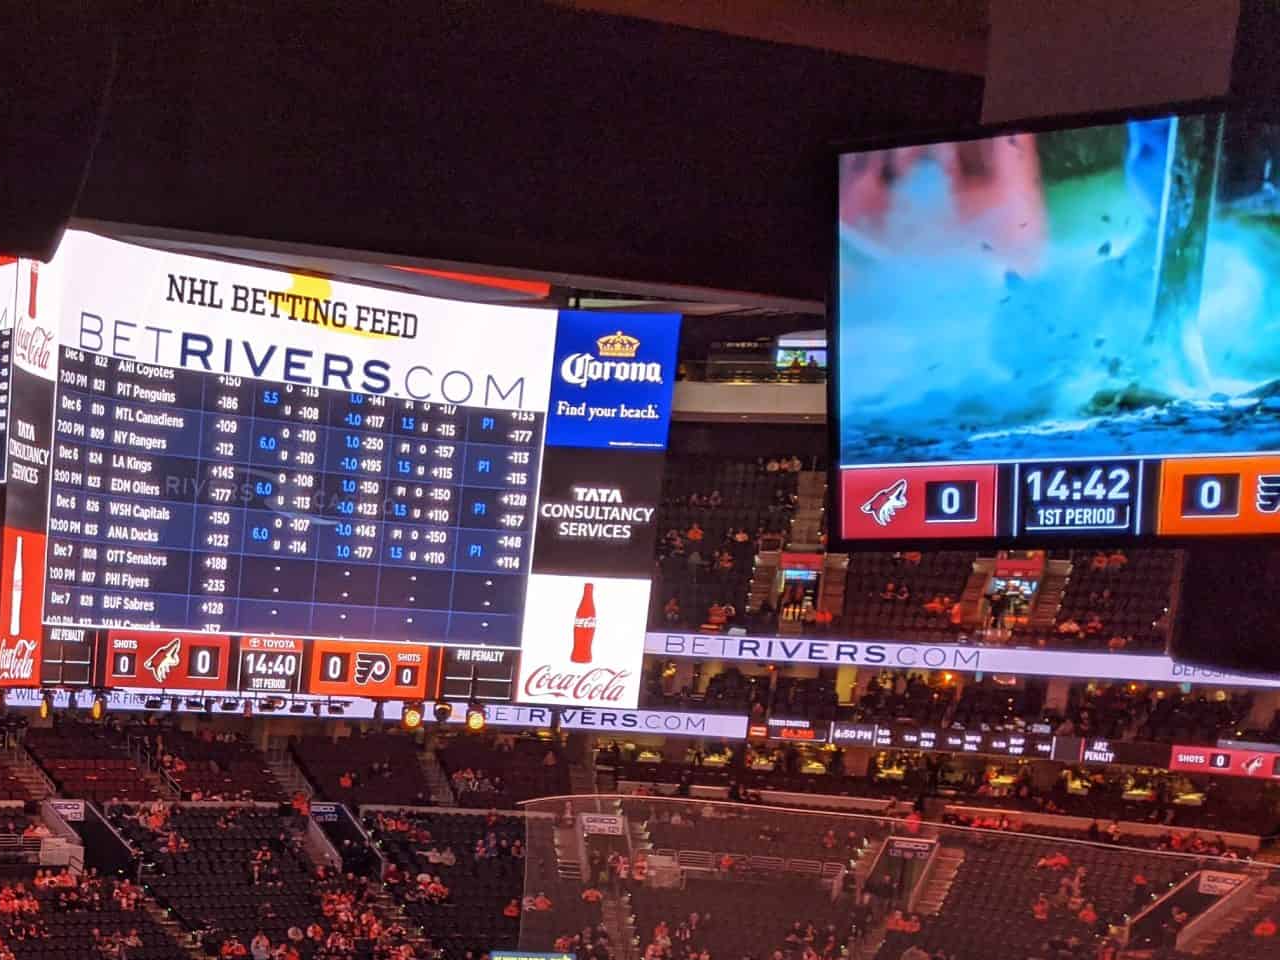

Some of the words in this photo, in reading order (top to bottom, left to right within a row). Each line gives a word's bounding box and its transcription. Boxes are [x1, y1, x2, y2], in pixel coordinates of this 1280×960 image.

[166, 273, 224, 310] NHL
[230, 284, 349, 330] BETTING
[352, 304, 419, 339] FEED
[79, 311, 525, 411] BETRIVERS.COM
[136, 363, 175, 380] Coyotes
[561, 353, 663, 389] Corona
[117, 381, 132, 396] PIT
[133, 384, 176, 404] Penguins
[217, 396, 239, 410] -186
[115, 406, 134, 421] MTL
[135, 410, 184, 429] Canadiens
[216, 420, 238, 433] -109
[557, 400, 587, 417] Find
[588, 405, 616, 422] your
[113, 430, 128, 444] NY
[130, 433, 167, 449] Rangers
[215, 443, 234, 457] -112
[112, 454, 126, 468] LA
[127, 456, 153, 474] Kings
[212, 466, 234, 480] +145
[111, 478, 130, 492] EDM
[132, 480, 160, 496] Oilers
[211, 489, 232, 502] -177
[573, 487, 623, 503] TATA
[1025, 468, 1131, 505] 14:42
[1200, 480, 1223, 510] 0
[941, 486, 961, 515] 0
[109, 501, 132, 517] WSH
[133, 504, 170, 521] Capitals
[208, 511, 230, 525] -150
[541, 503, 655, 523] CONSULTANCY
[1039, 509, 1063, 526] 1ST
[1064, 507, 1116, 526] PERIOD
[107, 525, 128, 539] ANA
[130, 528, 159, 543] Ducks
[207, 534, 229, 547] +123
[559, 522, 631, 539] SERVICES
[106, 550, 125, 563] OTT
[126, 552, 167, 566] Senators
[205, 557, 227, 570] +188
[105, 572, 120, 586] PHI
[121, 574, 150, 590] Flyers
[203, 579, 225, 592] -235
[103, 595, 122, 609] BUF
[123, 597, 155, 612] Sabres
[201, 601, 224, 615] +128
[113, 639, 138, 650] SHOTS
[263, 639, 295, 649] TOYOTA
[664, 634, 982, 668] BETRIVERS.COM
[119, 655, 129, 673] 0
[196, 650, 211, 674] 0
[245, 654, 297, 676] 14:40
[396, 653, 422, 664] SHOTS
[457, 648, 470, 661] PHI
[470, 649, 505, 664] PENALTY
[328, 655, 341, 680] 0
[402, 668, 411, 685] 0
[524, 664, 634, 702] Coca-Cola
[483, 707, 707, 732] BETRVERS.COM
[834, 728, 856, 740] 6:50
[856, 730, 872, 742] PM
[1178, 753, 1204, 764] SHOTS
[1216, 754, 1225, 767] 0
